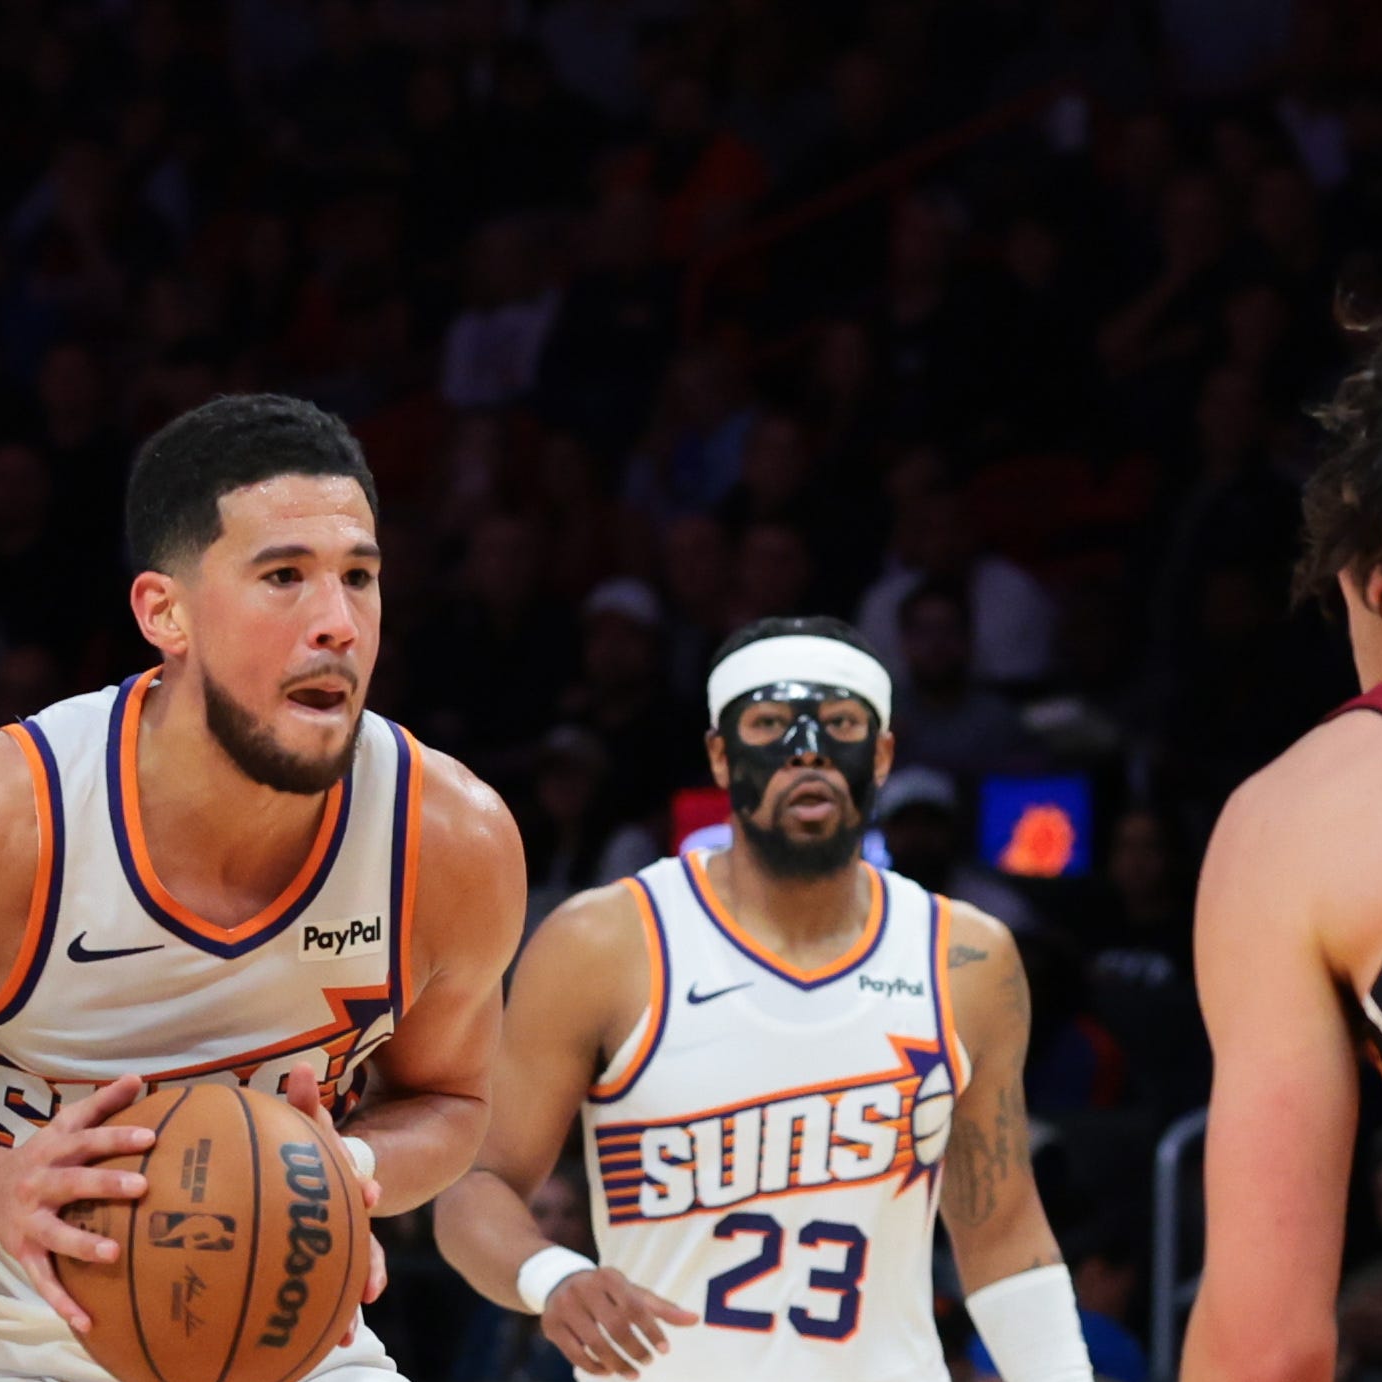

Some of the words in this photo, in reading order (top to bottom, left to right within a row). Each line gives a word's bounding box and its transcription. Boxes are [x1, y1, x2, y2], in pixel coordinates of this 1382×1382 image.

[303, 915, 381, 956] PayPal
[859, 975, 925, 999] PayPal
[637, 1079, 902, 1218] SUNS
[704, 1211, 868, 1344] 23
